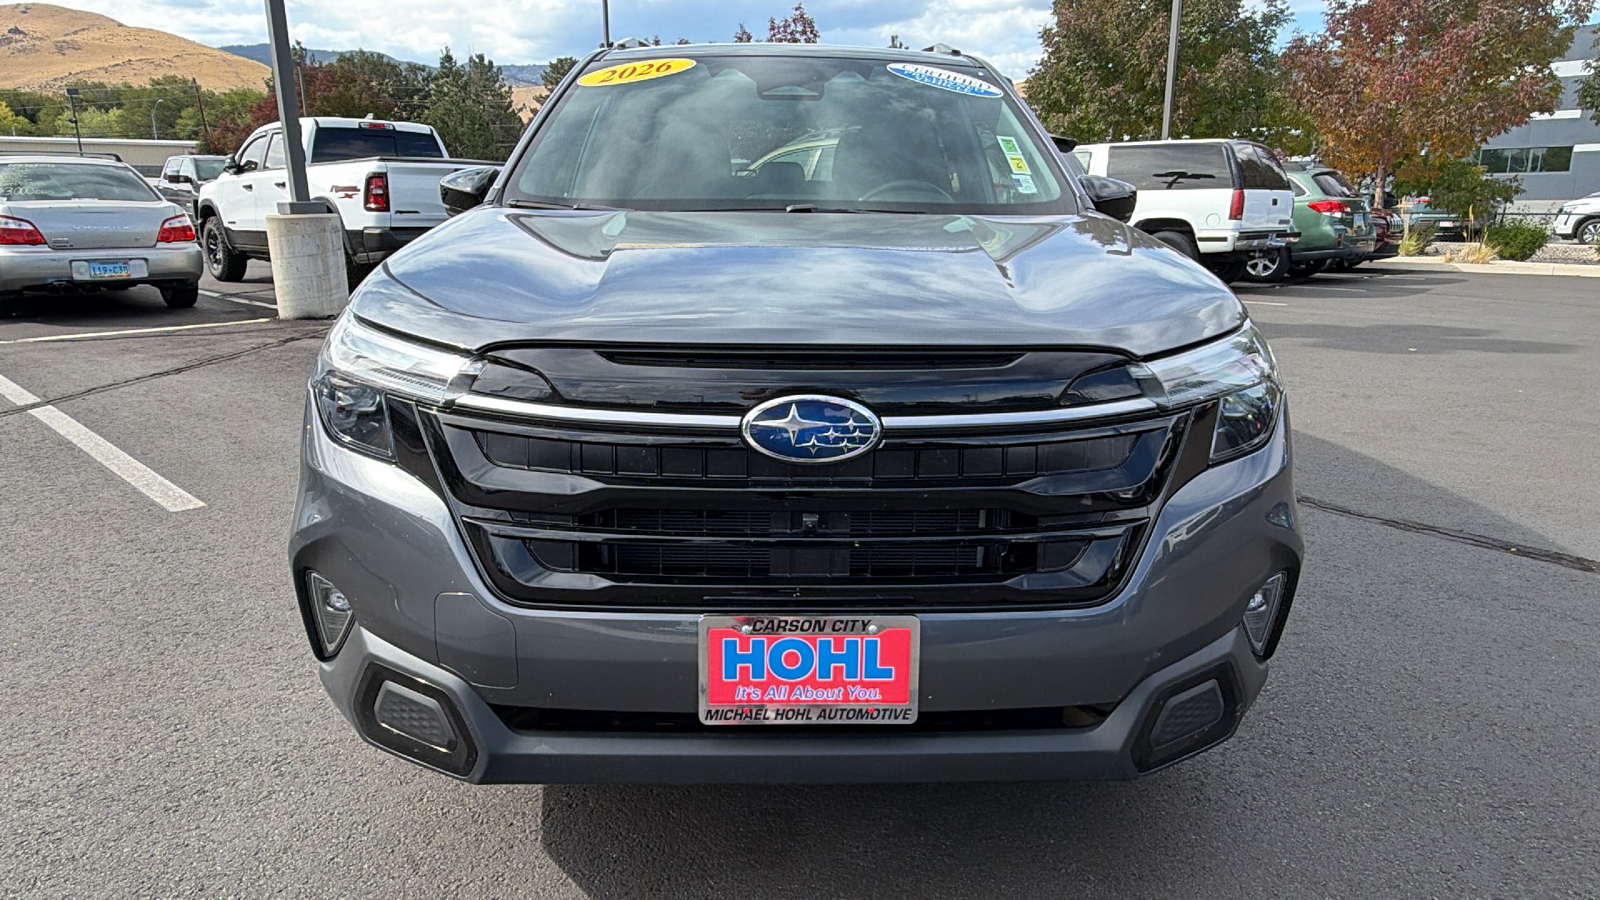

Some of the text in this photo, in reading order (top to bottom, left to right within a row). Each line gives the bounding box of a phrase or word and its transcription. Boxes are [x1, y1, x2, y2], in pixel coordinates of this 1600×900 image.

[597, 60, 675, 84] 2026
[902, 64, 991, 90] CERTIFIED
[752, 619, 871, 633] CARSON CITY
[723, 637, 894, 681] HOHL
[735, 685, 881, 700] It's All About You.
[705, 708, 912, 721] MICHAEL HOHL AUTOMOTIVE
